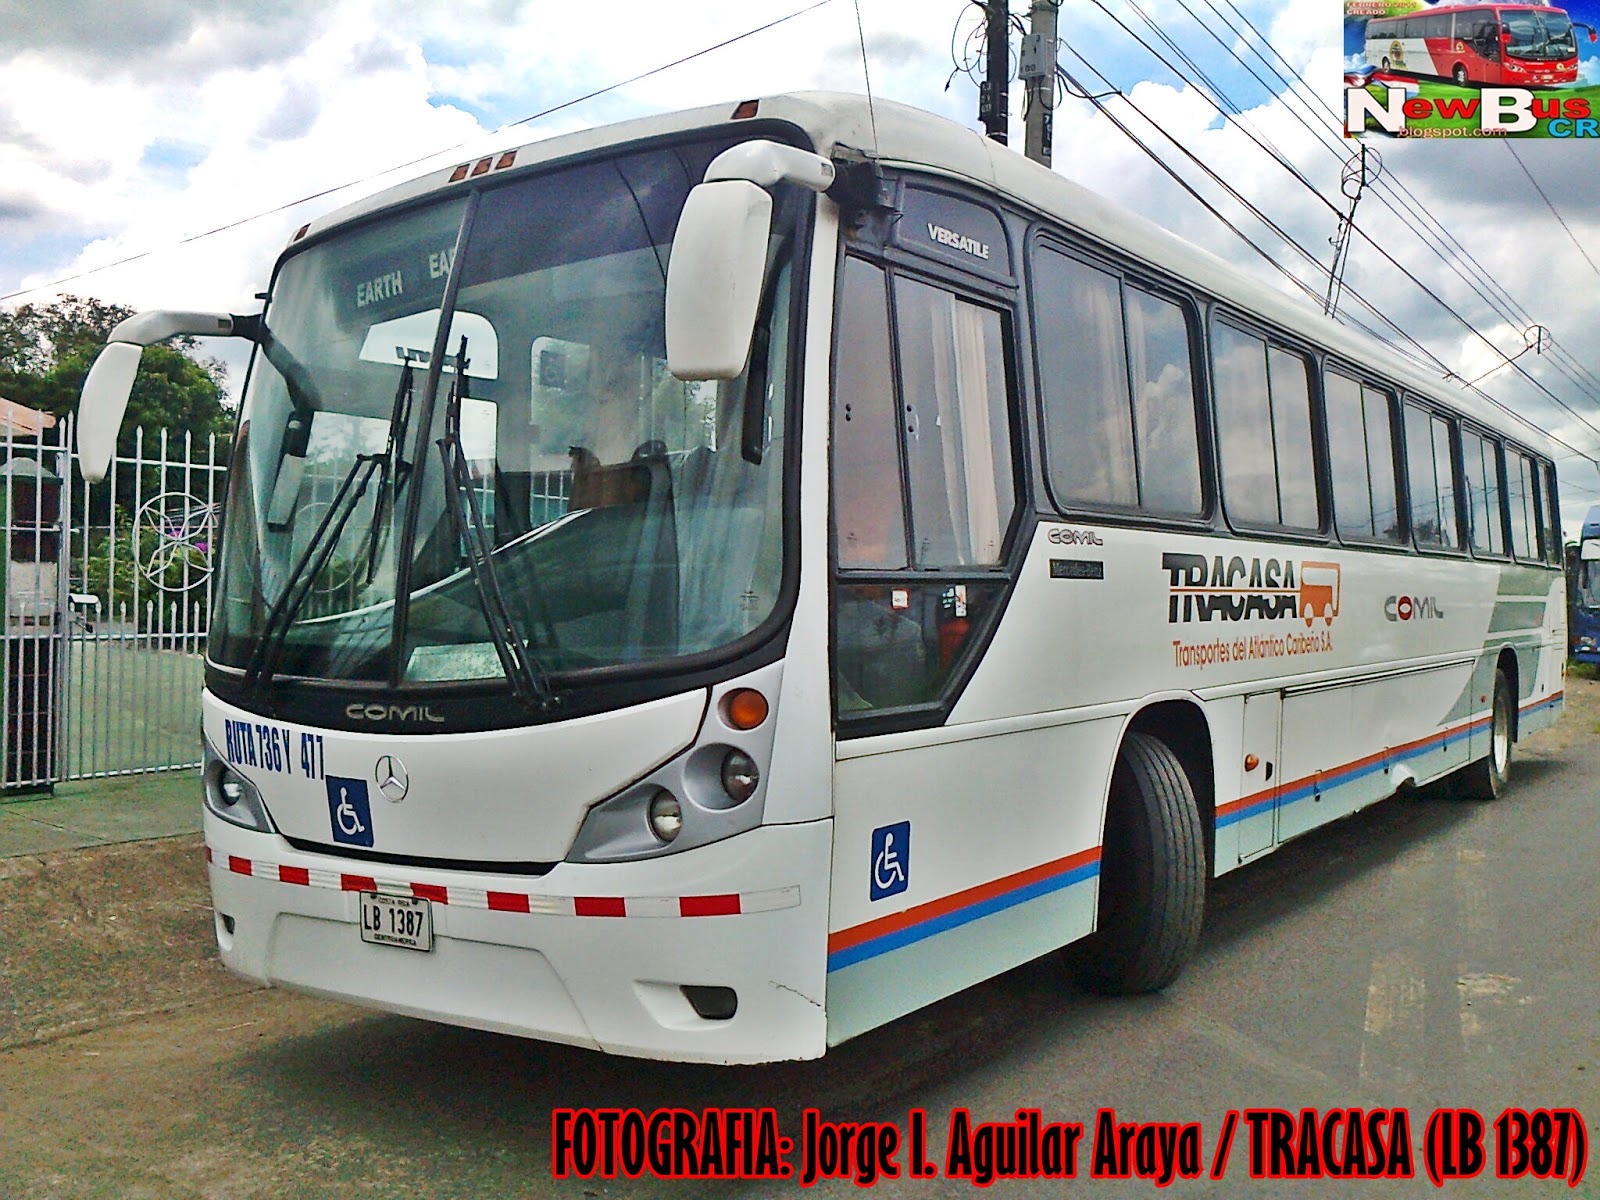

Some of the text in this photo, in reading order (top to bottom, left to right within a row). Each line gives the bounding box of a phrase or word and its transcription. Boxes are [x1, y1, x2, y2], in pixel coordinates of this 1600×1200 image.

[927, 222, 989, 260] VERSATILE
[357, 270, 403, 307] EARTH
[1047, 528, 1103, 546] COMIL
[1162, 552, 1297, 624] TRACASA
[1384, 595, 1444, 622] COMIL
[1173, 638, 1230, 670] Transportes
[1232, 635, 1247, 661] del
[346, 703, 446, 723] COMIL
[225, 718, 325, 781] RUTA 736 Y 477
[363, 904, 424, 938] LB 1387
